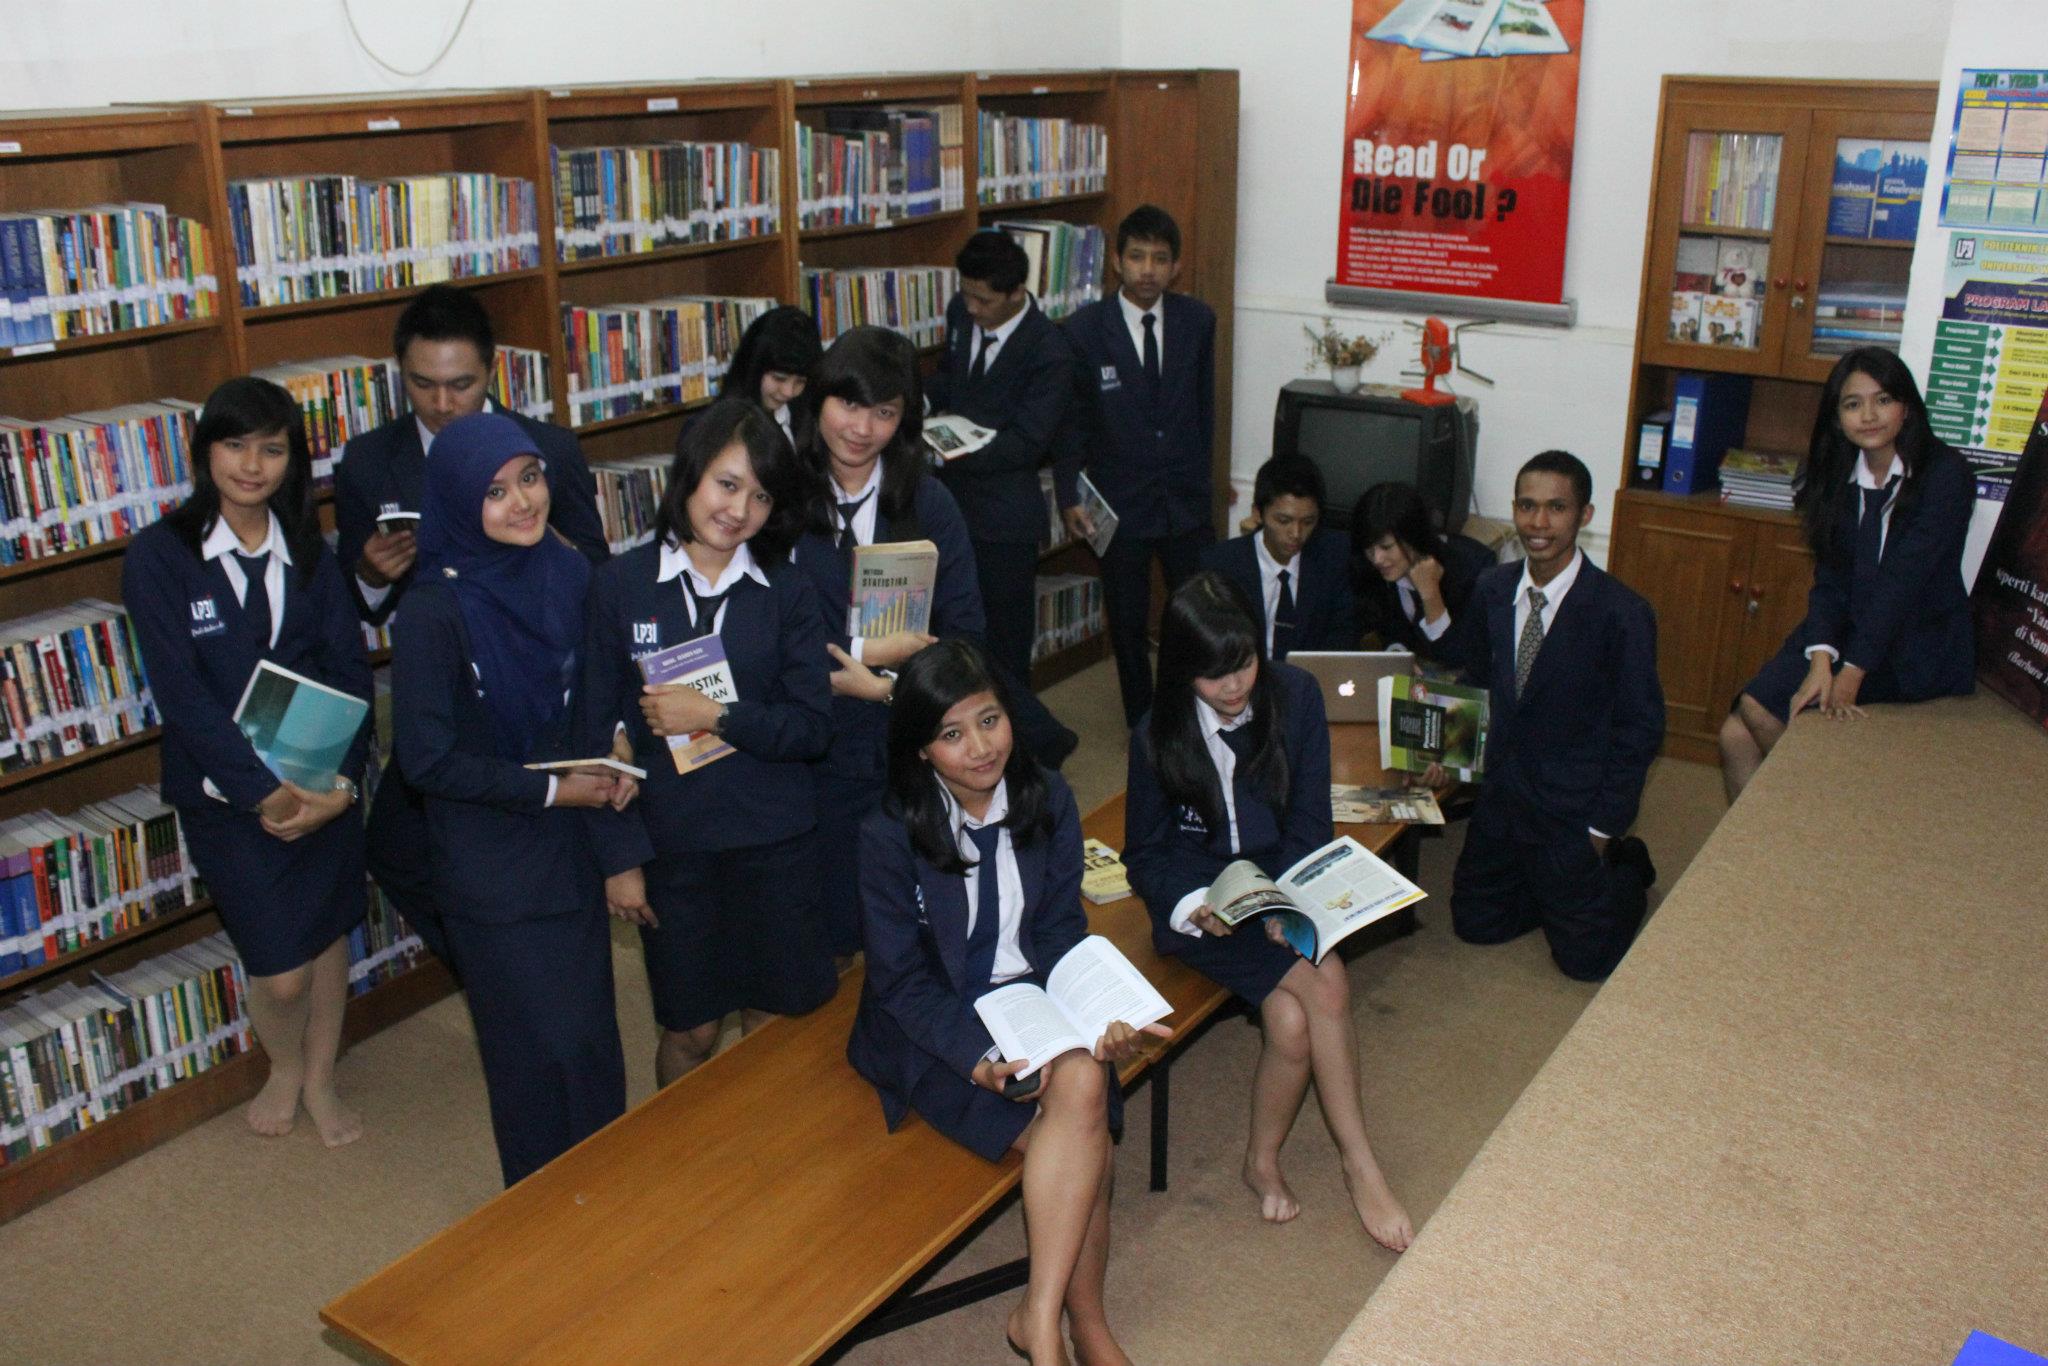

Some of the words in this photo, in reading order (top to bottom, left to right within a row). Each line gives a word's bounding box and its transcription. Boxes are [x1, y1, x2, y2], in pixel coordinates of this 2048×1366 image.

[1353, 138, 1438, 180] Read
[1447, 143, 1487, 182] Or
[1351, 177, 1402, 214] Die
[1414, 179, 1486, 220] Fool
[1497, 188, 1517, 222] ?
[1964, 293, 2030, 311] PROGRAM
[633, 623, 657, 644] LP3I
